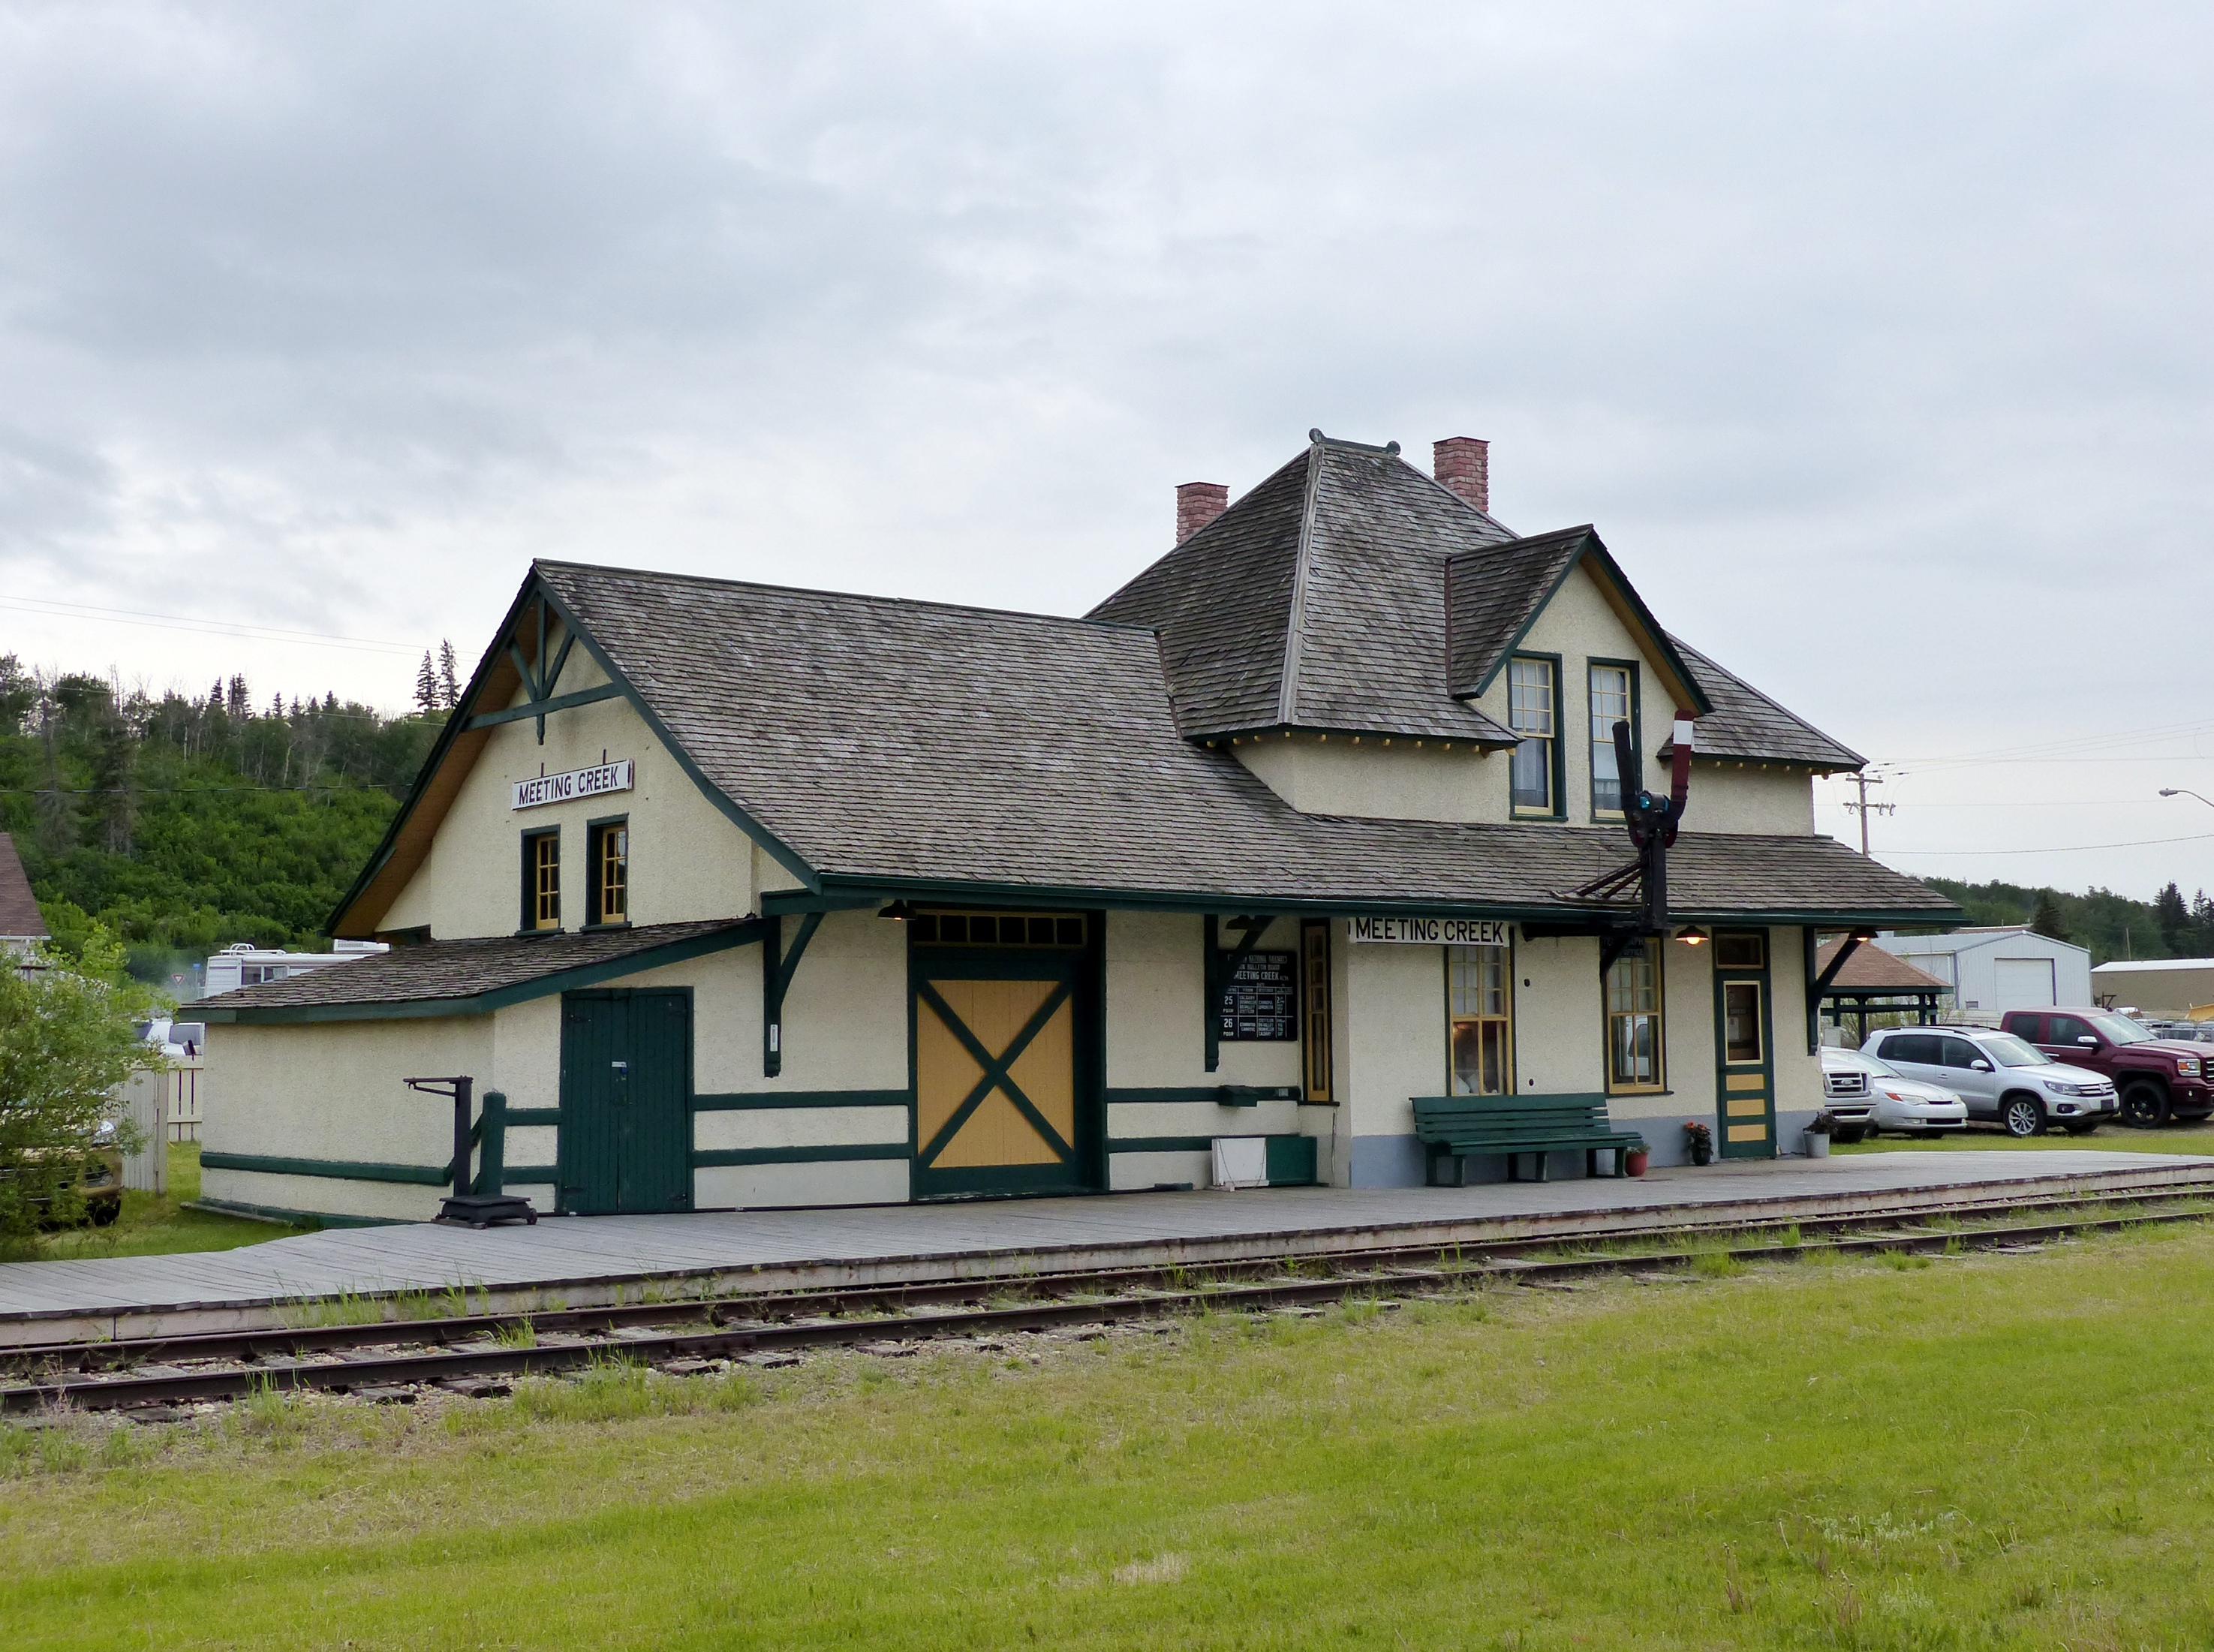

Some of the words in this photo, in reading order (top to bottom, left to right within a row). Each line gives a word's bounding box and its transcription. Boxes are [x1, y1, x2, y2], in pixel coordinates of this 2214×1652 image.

[519, 775, 572, 805] MEETING
[578, 766, 618, 793] CREEK
[1355, 917, 1439, 940] MEETING
[1444, 920, 1503, 943] CREEK
[1233, 970, 1259, 979] MEETING
[1261, 971, 1279, 980] CREEK
[1224, 995, 1233, 1005] 25
[1223, 1018, 1233, 1028] 26
